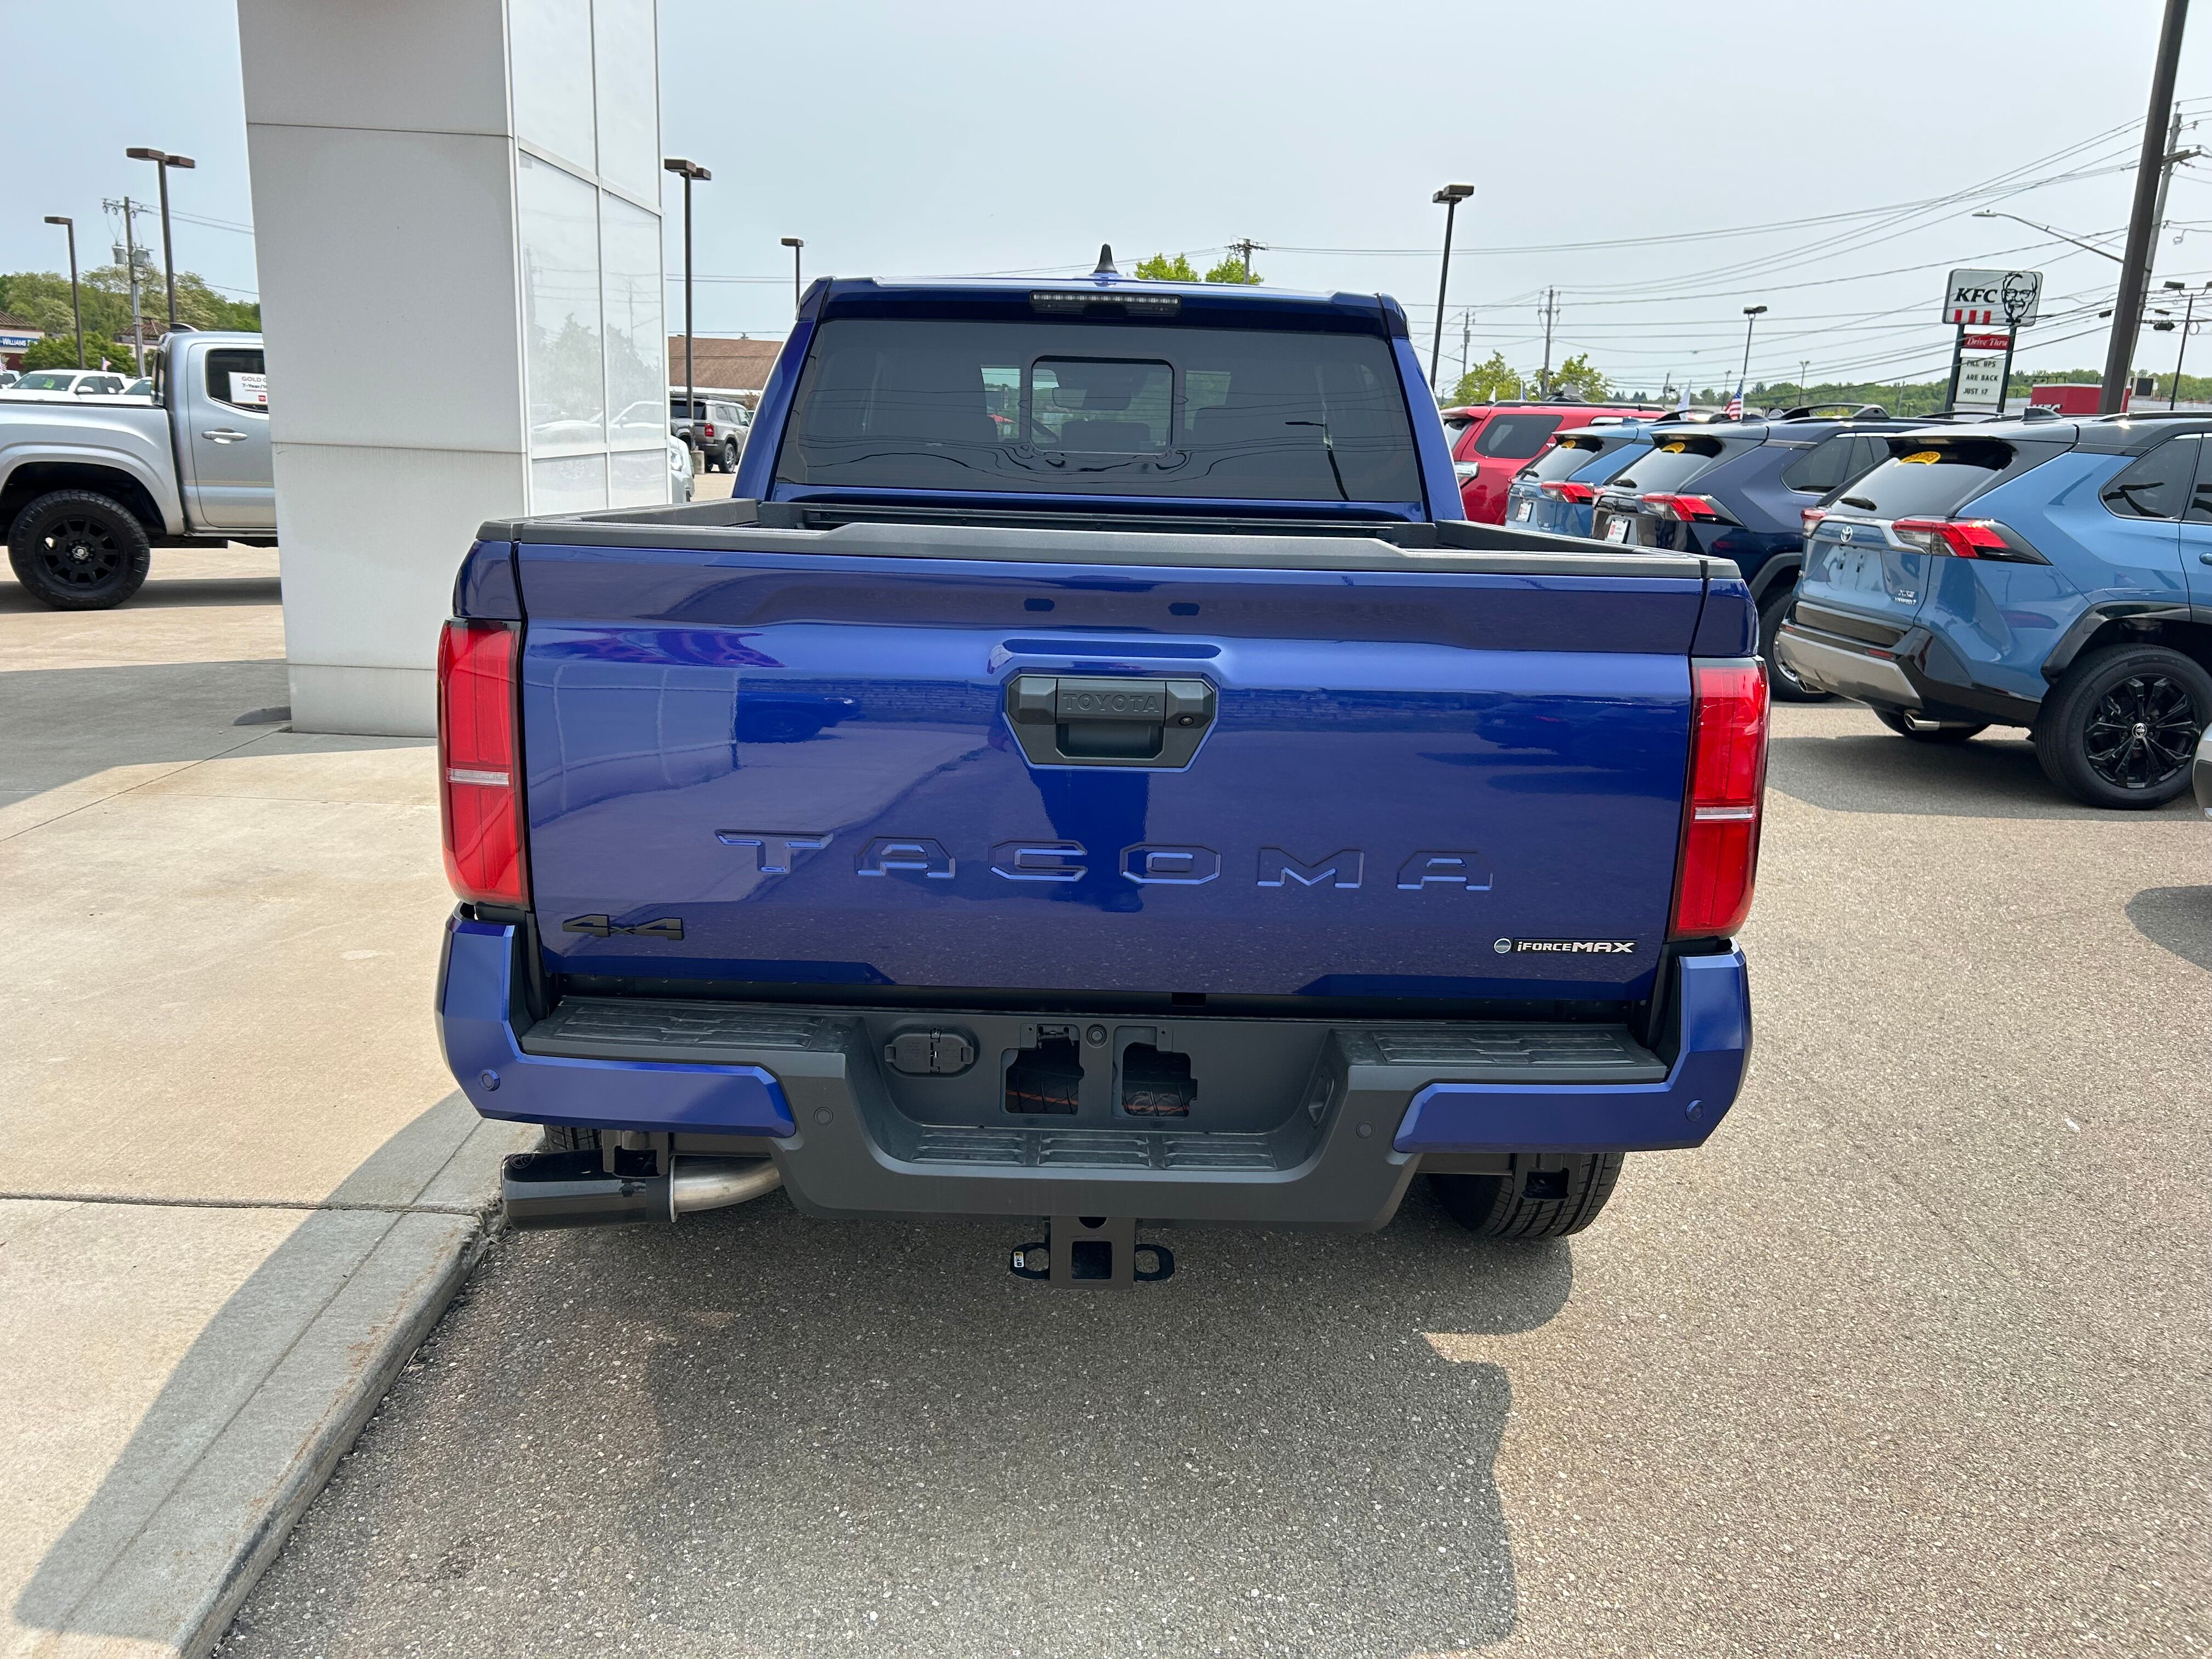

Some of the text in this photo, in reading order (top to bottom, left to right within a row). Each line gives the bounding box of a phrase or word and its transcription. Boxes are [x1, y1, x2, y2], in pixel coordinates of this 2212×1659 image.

[1954, 287, 1997, 303] KFC
[1967, 337, 2007, 347] Drive Thru
[1062, 693, 1160, 713] TOYOTA
[714, 829, 1493, 891] TACOMA
